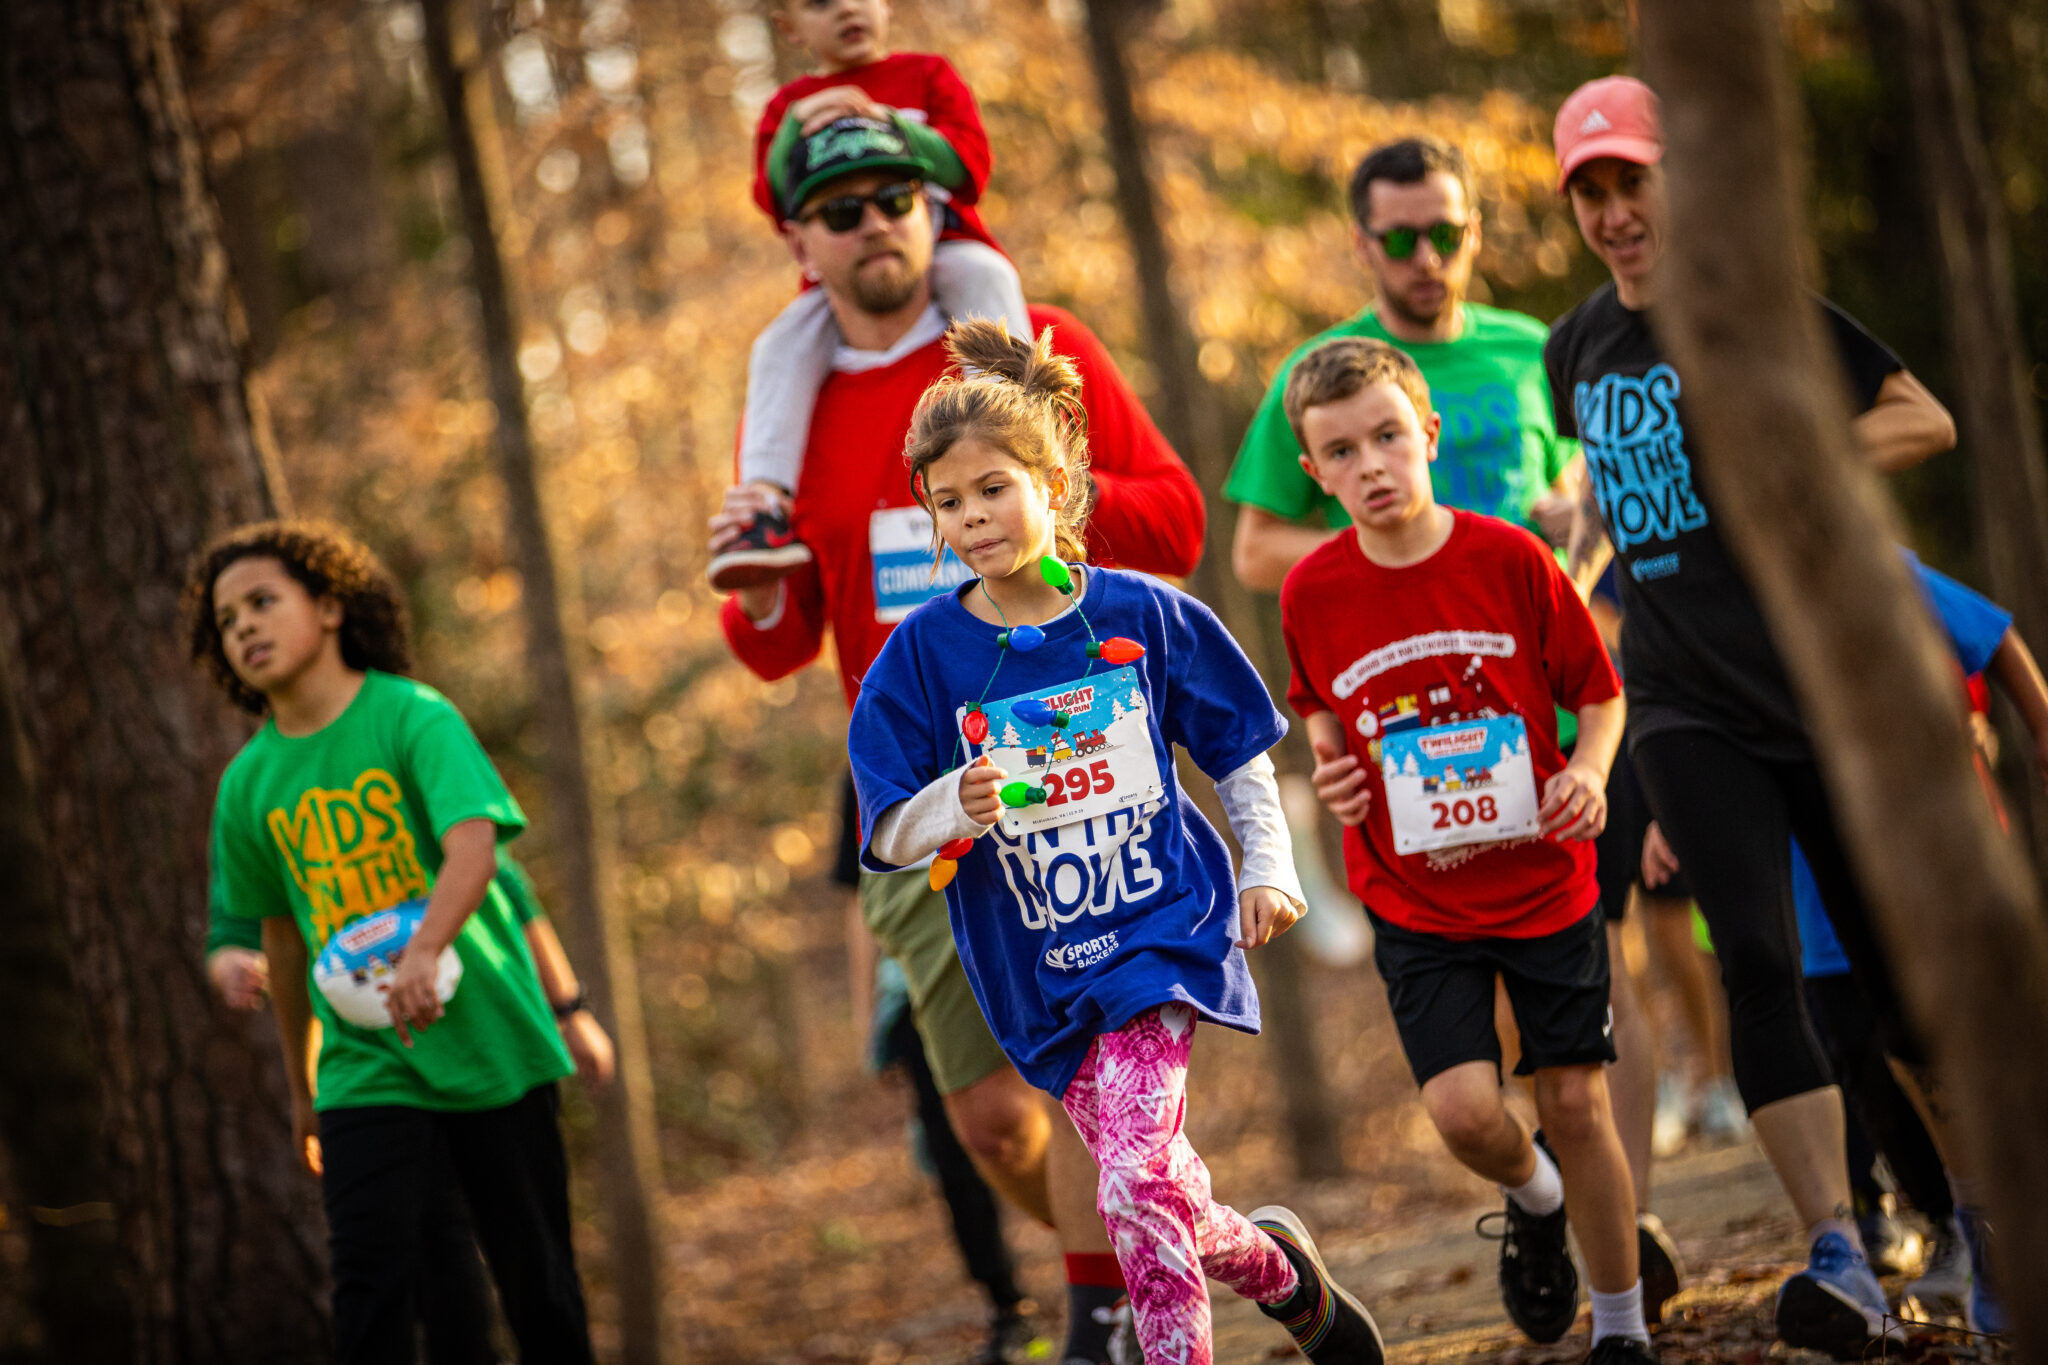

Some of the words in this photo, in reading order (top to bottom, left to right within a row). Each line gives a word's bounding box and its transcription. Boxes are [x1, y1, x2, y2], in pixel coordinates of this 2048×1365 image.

[1621, 431, 1683, 484] THE
[879, 562, 970, 595] COMPAN
[1044, 687, 1093, 710] LIGHT
[1074, 703, 1091, 712] RUN
[1043, 759, 1115, 807] 295
[270, 772, 400, 886] KIDS
[1431, 795, 1498, 831] 208
[1067, 931, 1116, 961] SPORTS
[1077, 940, 1119, 969] BACKERS
